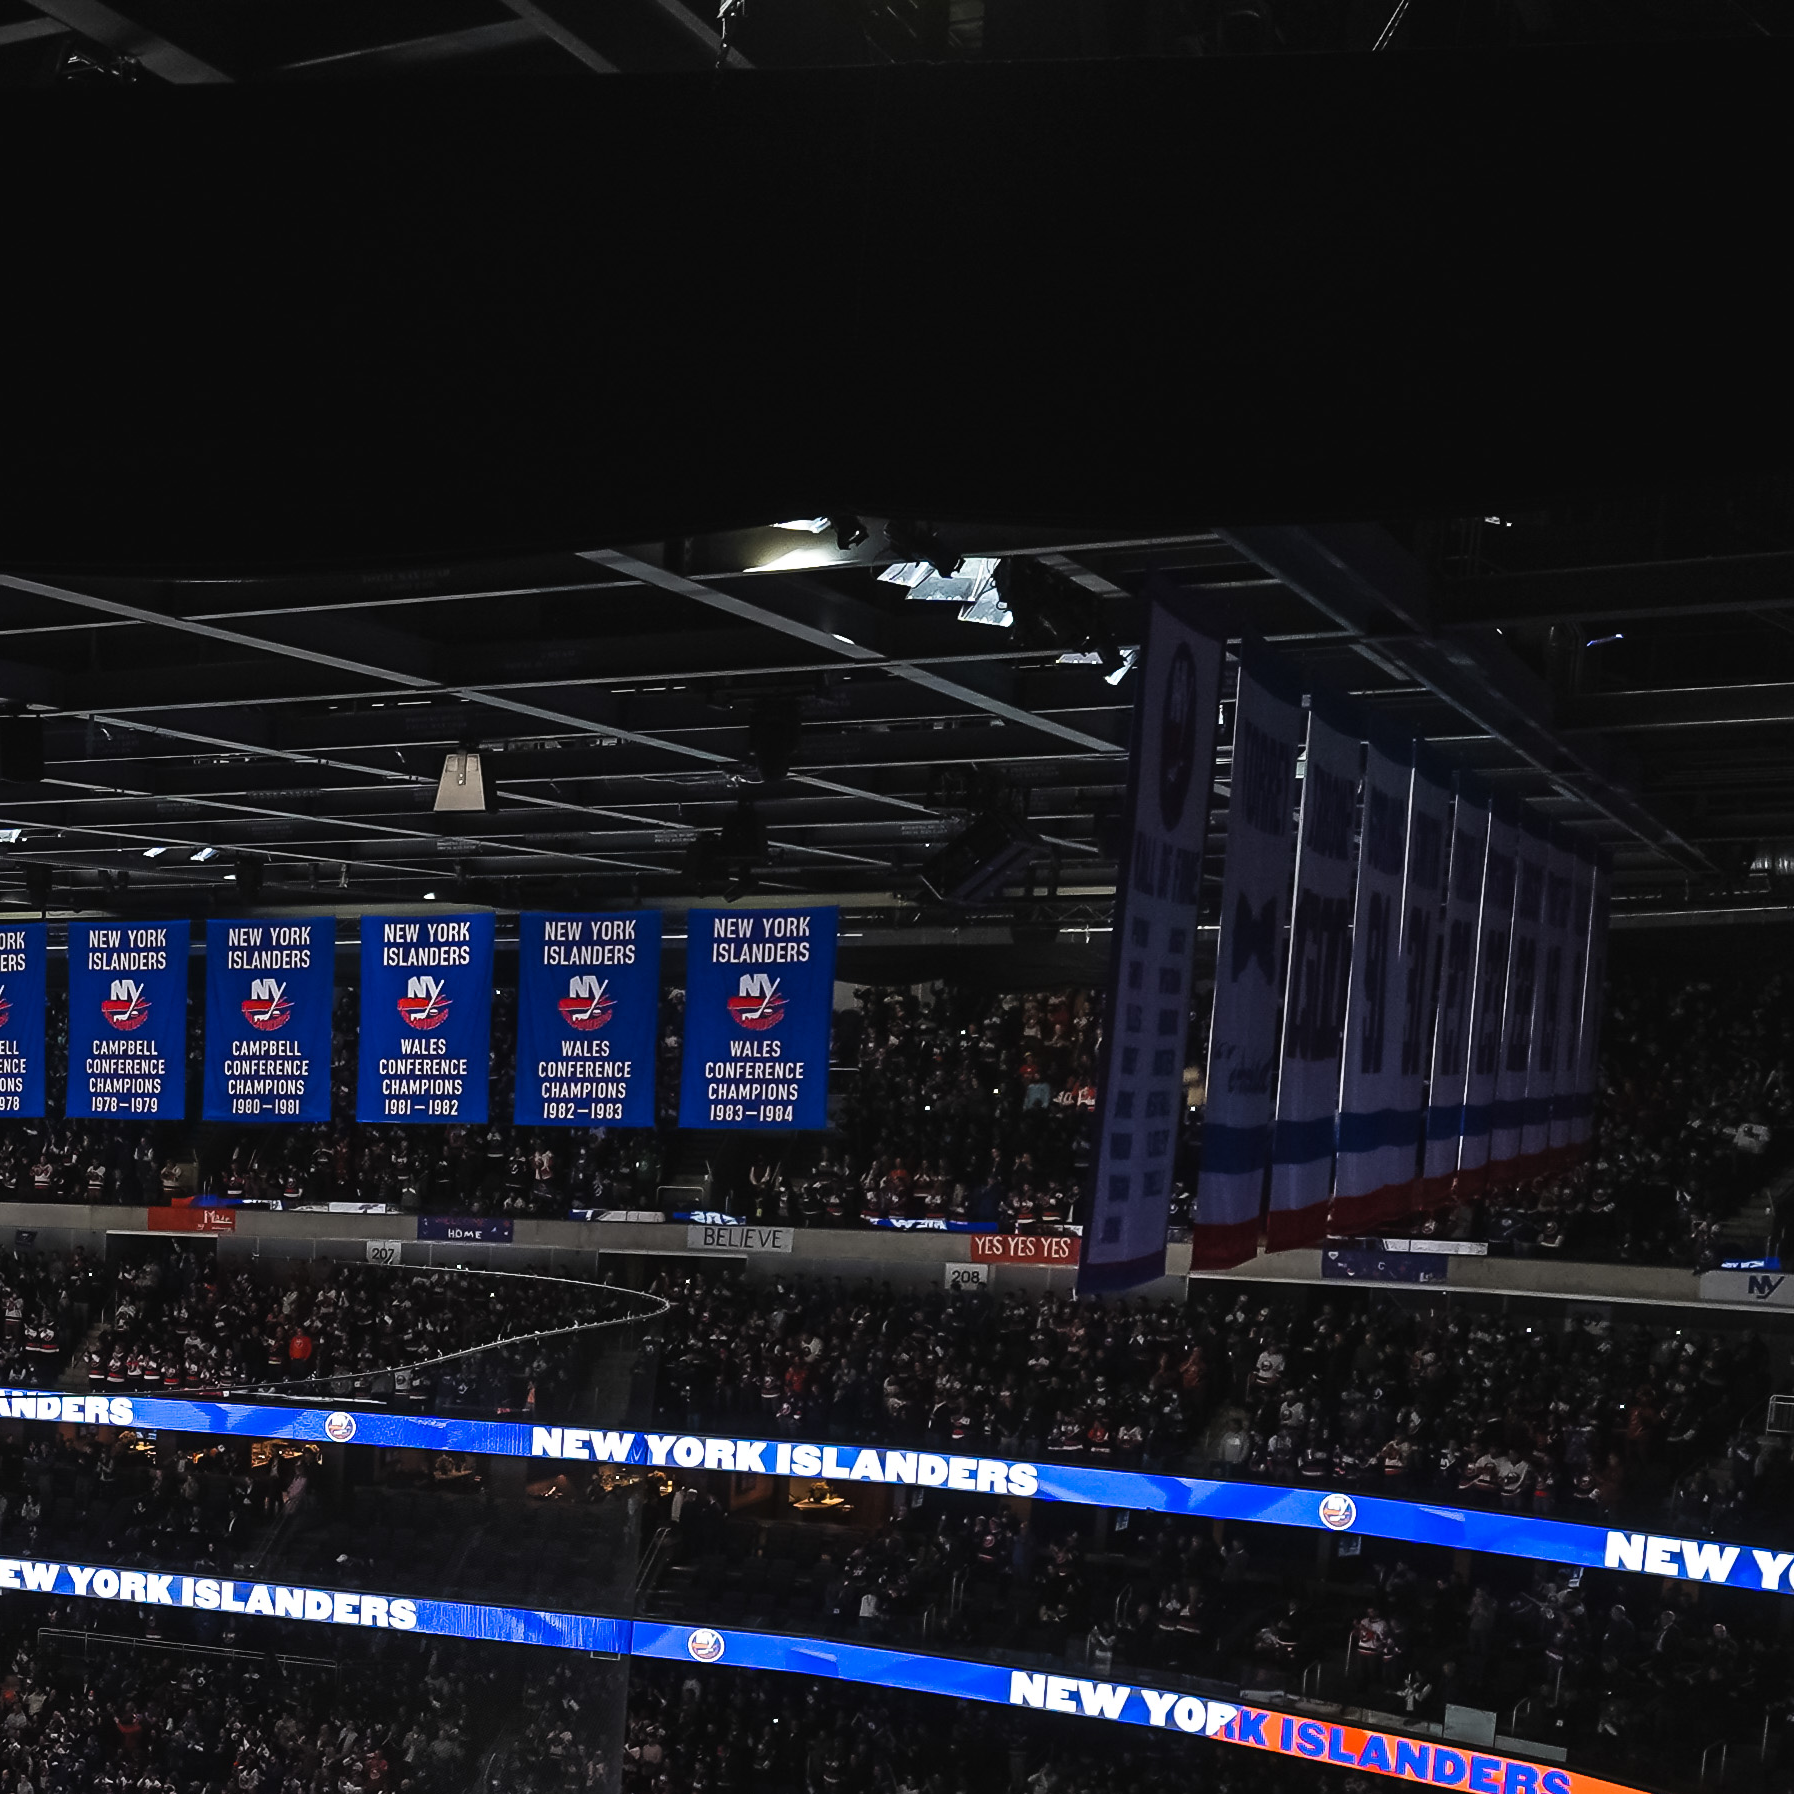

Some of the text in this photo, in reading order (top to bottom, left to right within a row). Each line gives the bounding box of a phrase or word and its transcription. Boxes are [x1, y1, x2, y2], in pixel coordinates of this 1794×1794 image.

[228, 926, 310, 945] NEW YORK
[384, 921, 470, 943] NEW YORK
[544, 920, 636, 941] NEW YORK
[714, 917, 810, 939] NEW YORK
[89, 929, 166, 948] NEW YORK
[88, 951, 166, 970] ISLANDERS
[228, 949, 310, 968] ISLANDERS
[383, 945, 470, 966] ISLANDERS
[544, 945, 635, 965] ISLANDERS
[713, 942, 809, 963] ISLANDERS
[93, 1040, 158, 1055] CAMPBELL
[232, 1041, 301, 1056] CAMPBELL
[401, 1038, 446, 1054] WALES
[562, 1040, 609, 1057] WALES
[730, 1041, 780, 1057] WALES
[86, 1059, 165, 1074] CONFERENCE
[224, 1060, 309, 1075] CONFERENCE
[379, 1059, 467, 1075] CONFERENCE
[538, 1062, 632, 1078] CONFERENCE
[705, 1062, 804, 1079] CONFERENCE
[89, 1078, 161, 1093] CHAMPIONS
[228, 1079, 304, 1094] CHAMPIONS
[382, 1080, 462, 1095] CHAMPIONS
[542, 1083, 626, 1099] CHAMPIONS
[708, 1084, 798, 1100] CHAMPIONS
[447, 1228, 482, 1239] HOME
[704, 1229, 782, 1249] BELIEVE
[372, 1247, 394, 1261] 207
[975, 1236, 1070, 1257] YES YES YES
[951, 1270, 980, 1285] 208
[532, 1427, 1039, 1498] NEW YORK ISLANDERS
[1604, 1531, 1741, 1583] NEW
[66, 1565, 176, 1605] YORK
[181, 1576, 418, 1630] ISLANDERS
[1010, 1669, 1131, 1721] NEW
[1141, 1689, 1270, 1746] YORK
